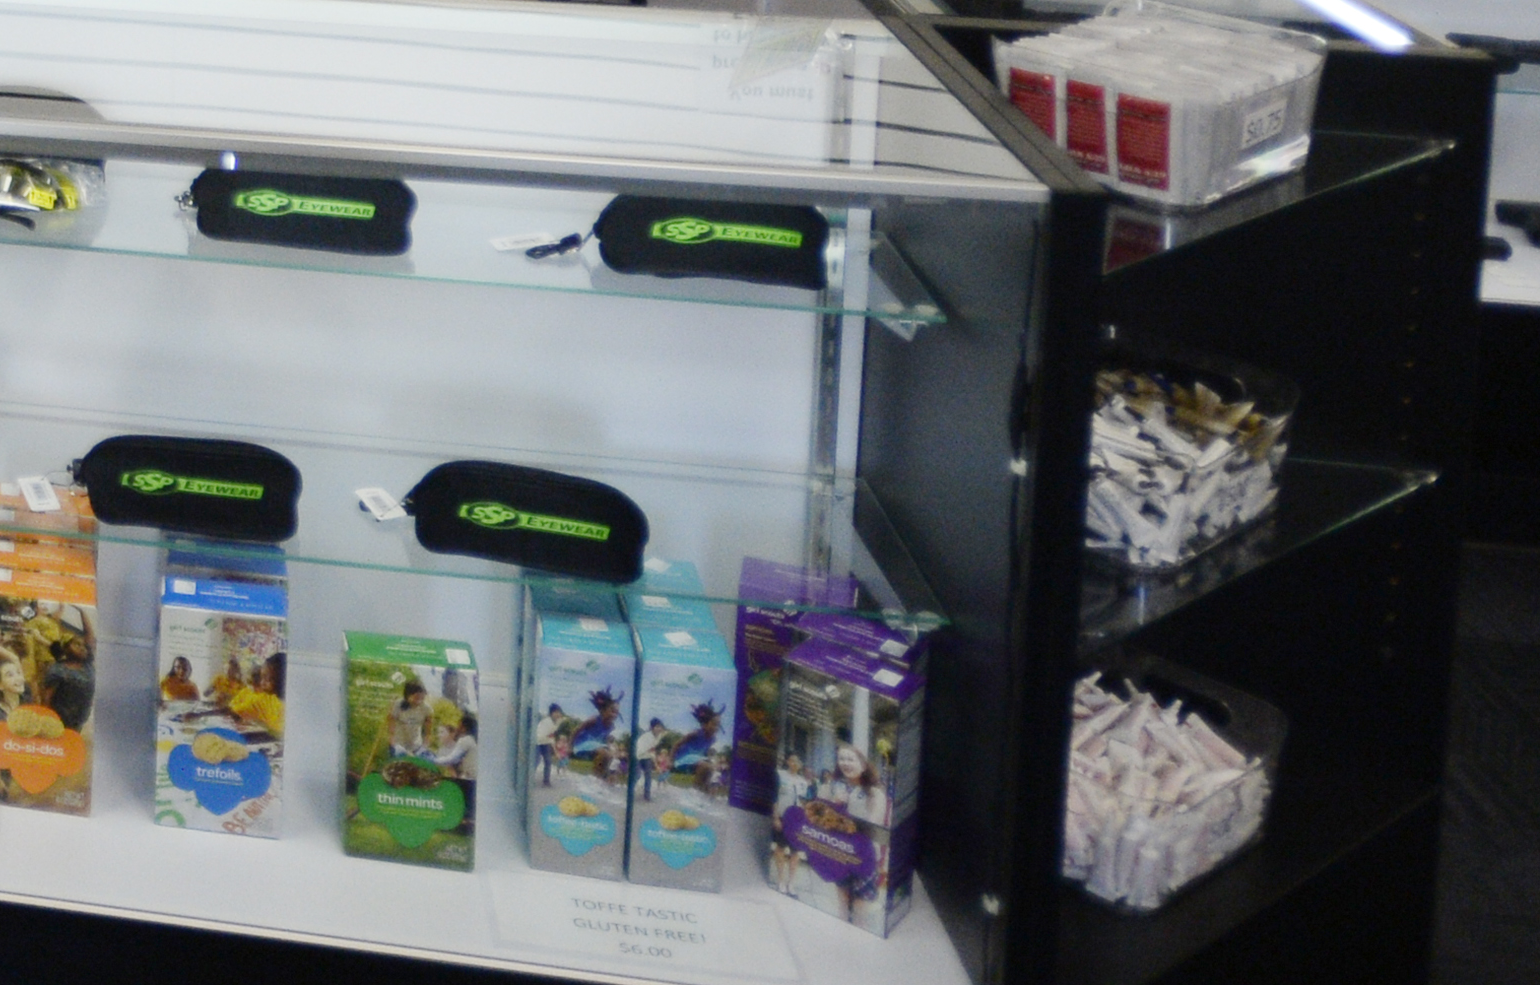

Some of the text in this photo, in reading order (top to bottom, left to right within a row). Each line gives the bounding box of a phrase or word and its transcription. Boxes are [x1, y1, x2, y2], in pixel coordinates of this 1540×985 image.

[3, 740, 64, 757] do-si-dos
[195, 766, 242, 780] trefoils
[377, 791, 443, 810] thin mints
[801, 825, 856, 854] samoas
[571, 897, 698, 924] TOFFE TASTIC
[572, 917, 706, 944] GLUTEN FREE!
[619, 942, 673, 959] $6.00
